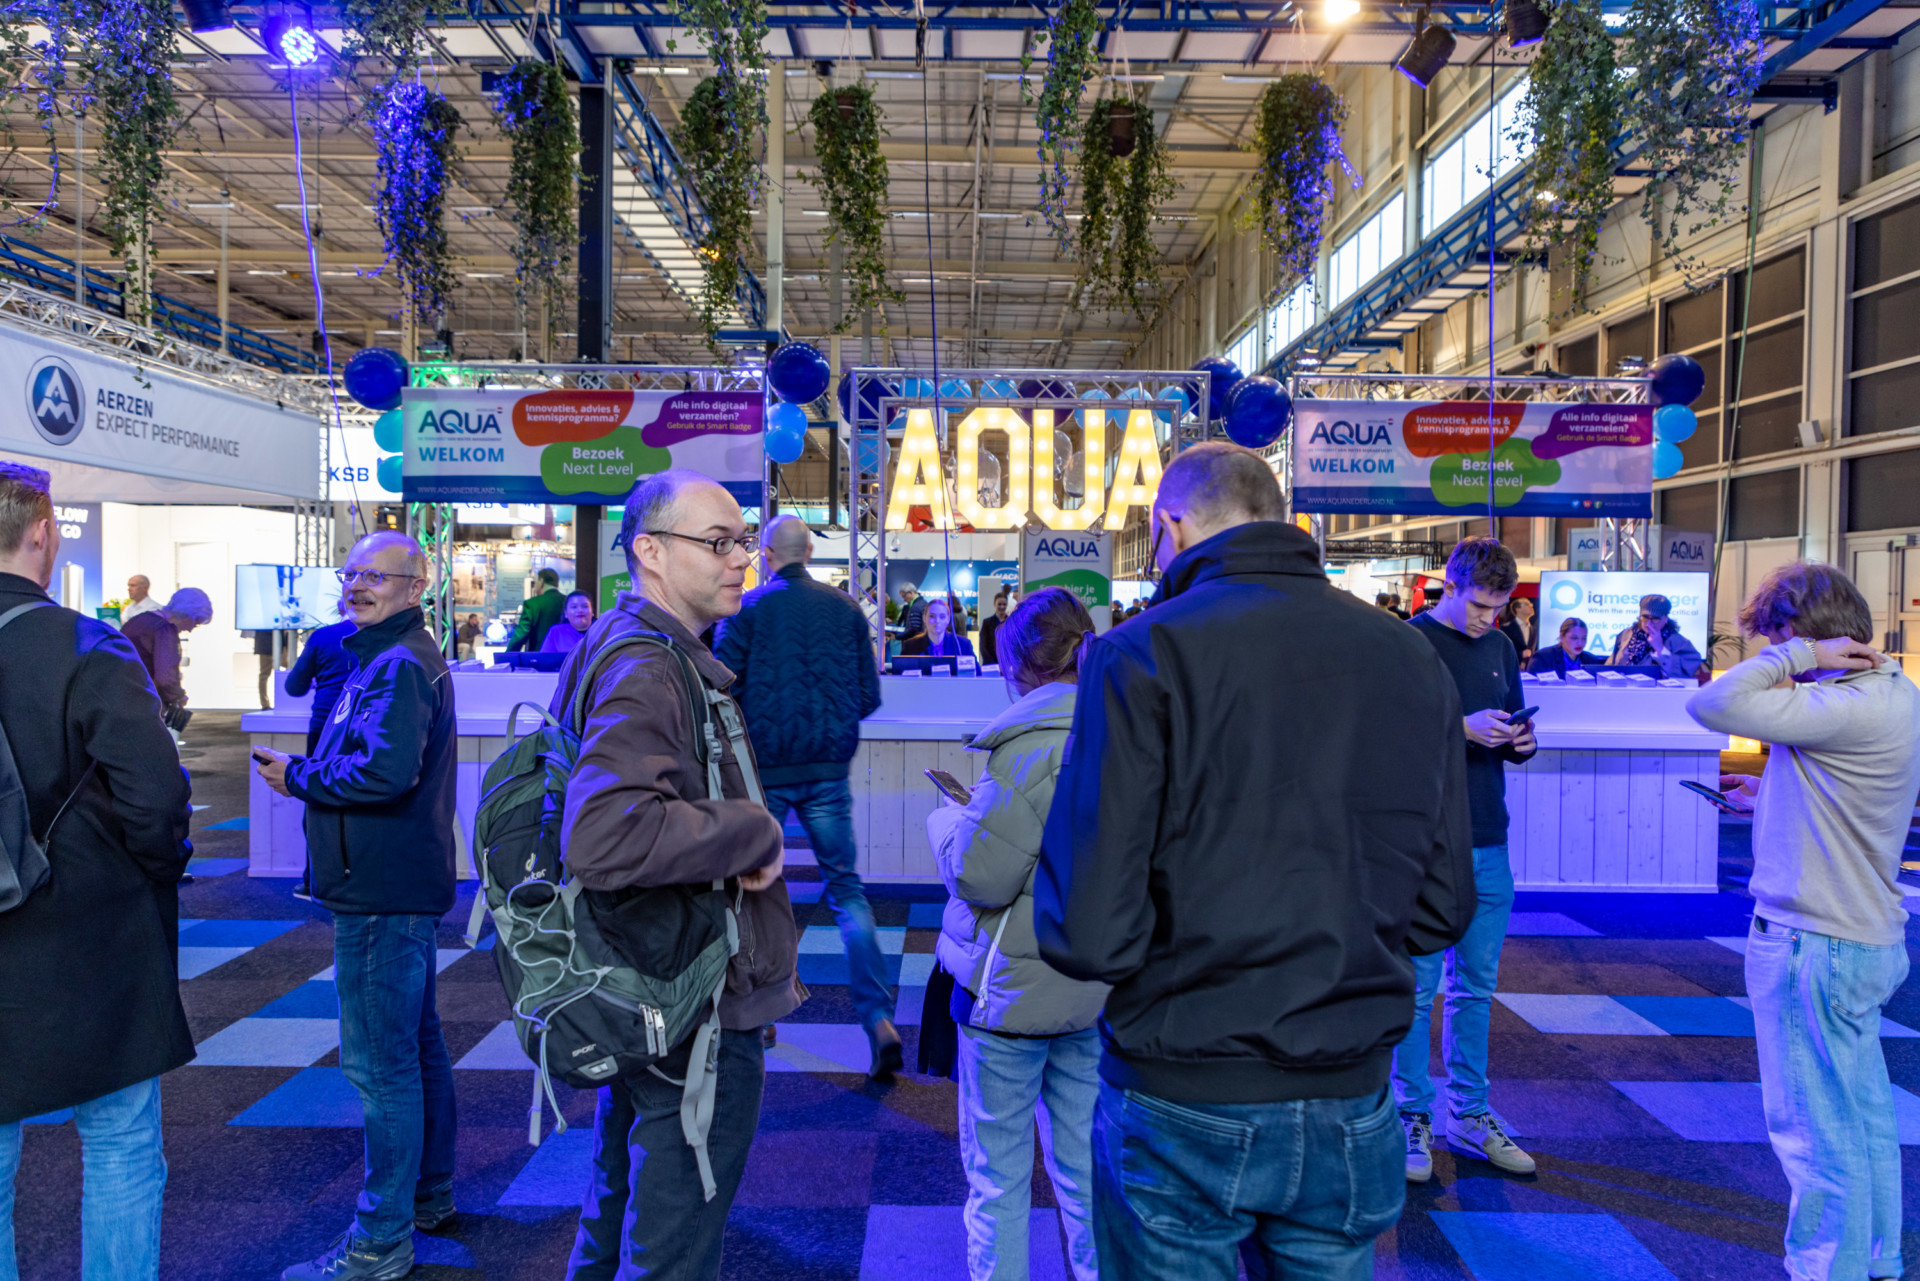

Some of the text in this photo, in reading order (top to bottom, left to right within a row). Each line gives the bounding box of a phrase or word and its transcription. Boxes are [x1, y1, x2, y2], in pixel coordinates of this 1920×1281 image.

[97, 388, 153, 418] AERZEN
[525, 403, 620, 413] Innovaties, advies &
[671, 401, 748, 412] Alle info digitaal
[418, 408, 502, 434] AQUA
[527, 413, 619, 424] kennisprogramma?
[679, 412, 739, 421] verzamelen?
[1416, 415, 1510, 425] Innovaties, adves &
[1560, 412, 1638, 424] Alle info digitaal
[666, 422, 694, 430] Gebruik
[696, 422, 705, 430] de
[729, 423, 752, 432] Badge
[1309, 420, 1393, 445] AQUA
[1569, 424, 1629, 433] verzamelen?
[96, 411, 240, 458] EXPECT PERFORMANCE
[1597, 434, 1618, 442] Smart
[1619, 434, 1641, 444] Badge
[418, 447, 504, 463] WELKOM
[572, 447, 624, 460] Bezoek
[563, 462, 634, 475] Next Level
[884, 407, 1164, 530] AQUA
[1309, 458, 1395, 474] WELKOM
[329, 466, 369, 481] KSB
[1453, 473, 1485, 487] Next
[417, 486, 506, 495] WWW.AQUANEDERLAND.NL
[1307, 497, 1395, 506] WWW.AQUANEDERLAND.NL
[61, 524, 82, 540] GO
[1035, 538, 1100, 557] AQUA
[1670, 541, 1704, 560] AQUA
[615, 578, 631, 588] Sca
[1085, 584, 1095, 595] je
[1081, 595, 1098, 605] dge
[1588, 590, 1699, 608] iqmesger
